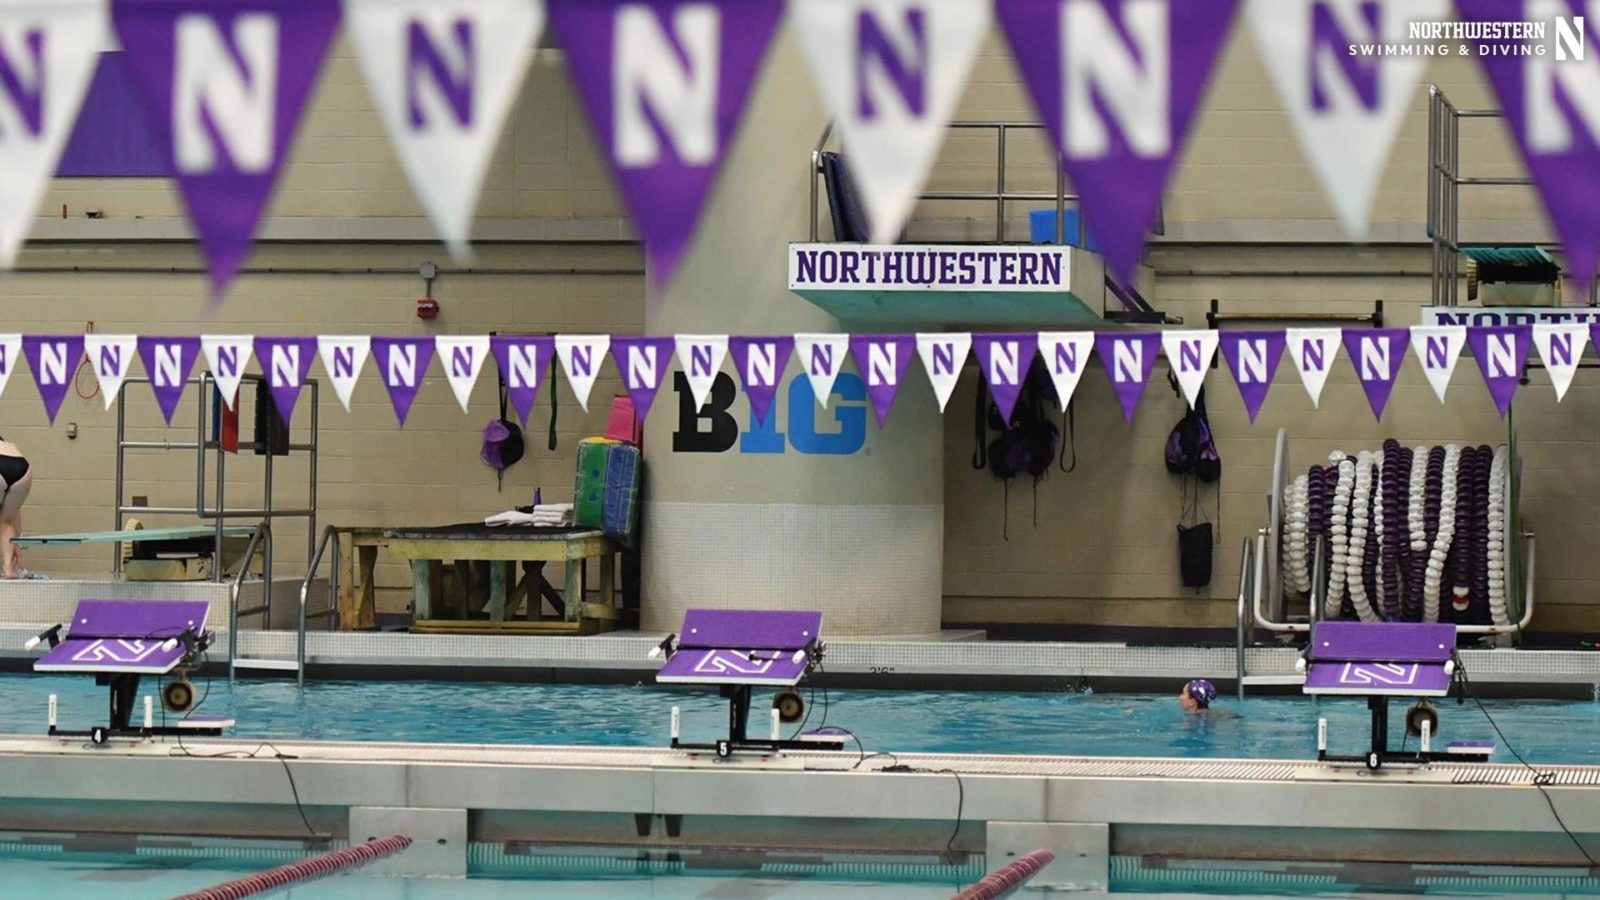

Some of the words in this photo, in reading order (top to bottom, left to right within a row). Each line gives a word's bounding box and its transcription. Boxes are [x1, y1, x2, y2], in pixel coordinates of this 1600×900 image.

[407, 18, 473, 131] N
[855, 6, 928, 120] N
[1308, 0, 1383, 115] N
[0, 27, 44, 139] N
[174, 15, 277, 171] N
[614, 6, 718, 165] N
[1061, 0, 1170, 157] N
[796, 250, 1062, 285] NORTHWESTERN
[40, 343, 66, 384] N
[101, 345, 120, 376] N
[155, 345, 181, 386] N
[218, 346, 237, 377] N
[272, 345, 299, 387] N
[334, 347, 353, 378] N
[389, 345, 416, 386] N
[453, 346, 472, 377] N
[509, 345, 536, 387] N
[572, 346, 591, 376] N
[629, 346, 656, 388] N
[692, 345, 711, 376] N
[748, 344, 775, 385] N
[811, 344, 832, 376] N
[869, 343, 896, 385] N
[933, 343, 953, 375] N
[991, 342, 1018, 384] N
[1056, 342, 1076, 374] N
[1114, 340, 1142, 382] N
[1180, 340, 1200, 372] N
[1239, 340, 1266, 382] N
[1303, 339, 1323, 371] N
[1362, 337, 1389, 380] N
[1427, 336, 1448, 369] N
[1487, 334, 1516, 377] N
[1550, 333, 1571, 366] N
[93, 729, 101, 743] 4
[720, 742, 728, 756] 5
[1370, 753, 1378, 767] 6
